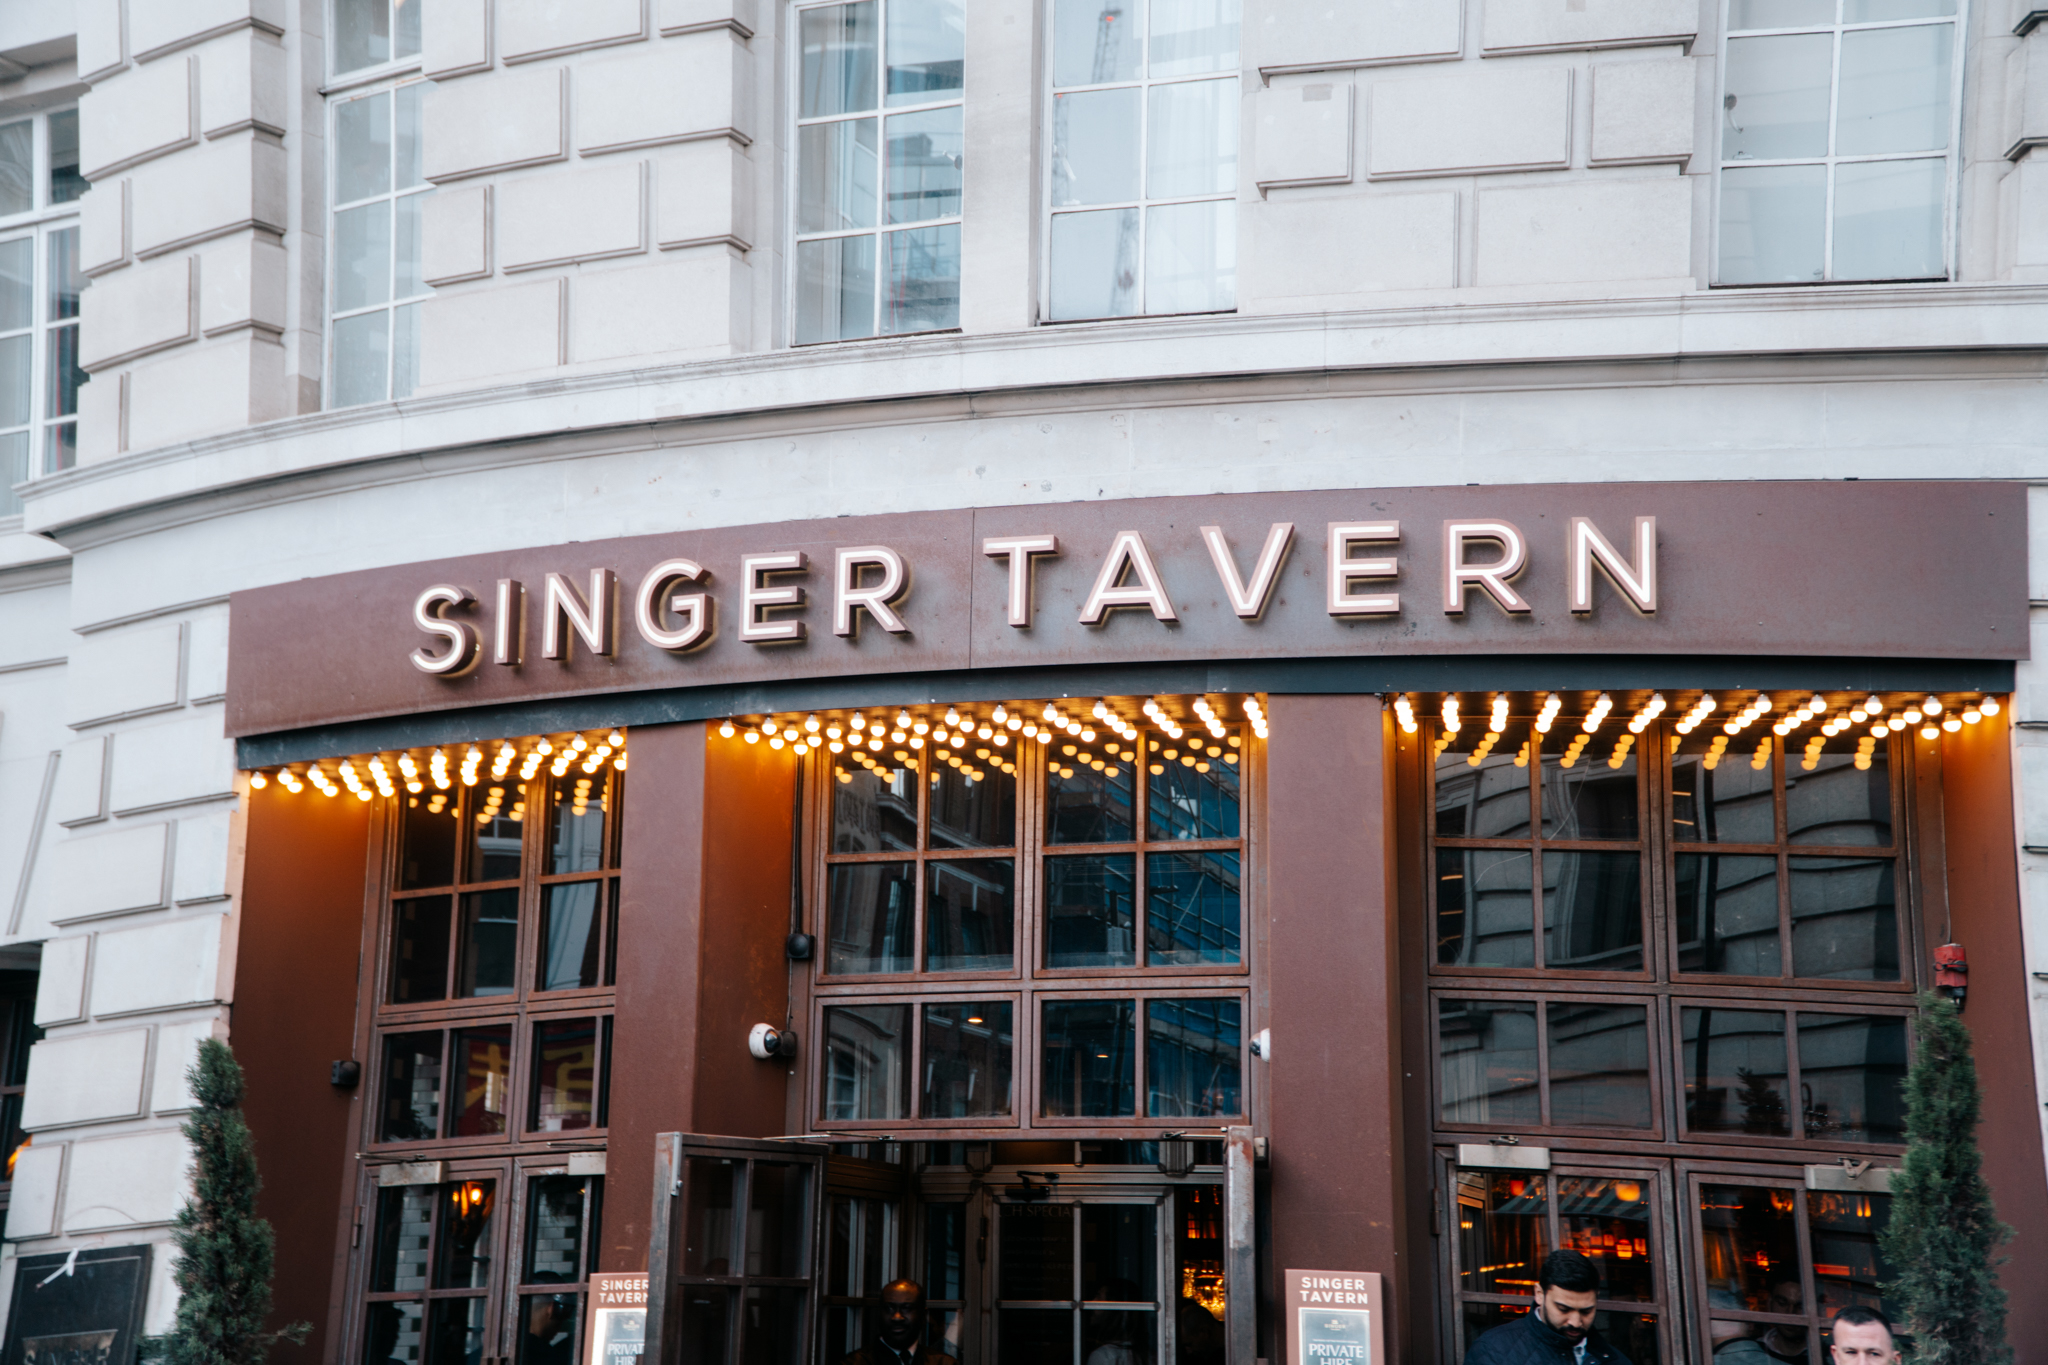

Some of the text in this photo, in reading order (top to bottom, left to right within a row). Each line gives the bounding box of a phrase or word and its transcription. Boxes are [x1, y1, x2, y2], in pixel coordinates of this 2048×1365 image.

[408, 515, 1657, 677] SINGER TAVERN
[1026, 1205, 1075, 1218] SPECIA
[1301, 1276, 1365, 1291] SINGER
[1299, 1290, 1368, 1304] TAVERN
[607, 1343, 645, 1355] PRIVAT
[1308, 1343, 1364, 1358] PRIVATE
[1320, 1357, 1353, 1365] HIRE
